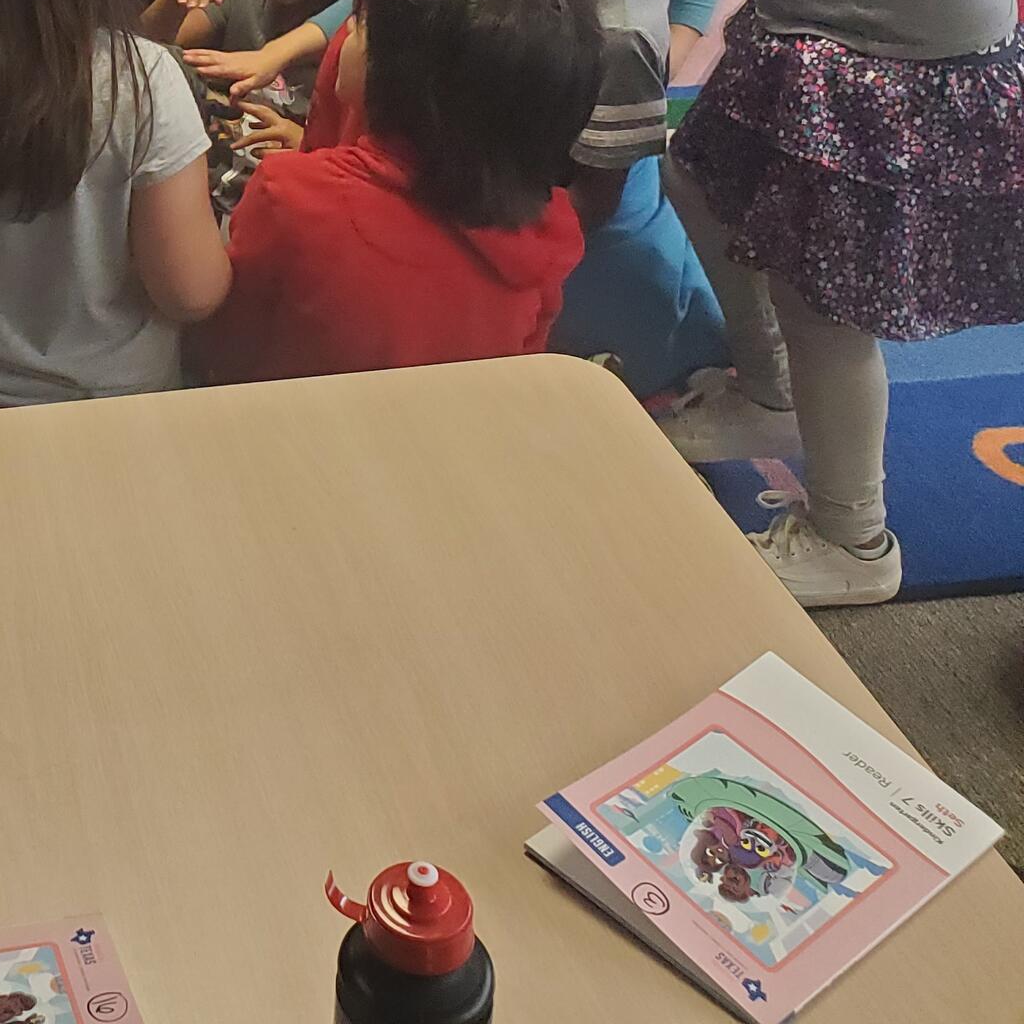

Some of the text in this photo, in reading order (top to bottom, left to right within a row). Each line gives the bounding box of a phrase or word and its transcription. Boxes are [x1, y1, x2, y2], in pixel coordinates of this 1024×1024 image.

[841, 751, 956, 837] Skills 7 Reader
[889, 801, 944, 844] Kindergarten
[935, 802, 965, 828] Seth
[576, 821, 616, 858] ENGLISH
[79, 945, 97, 965] TEXAS
[714, 951, 746, 980] TEXAS
